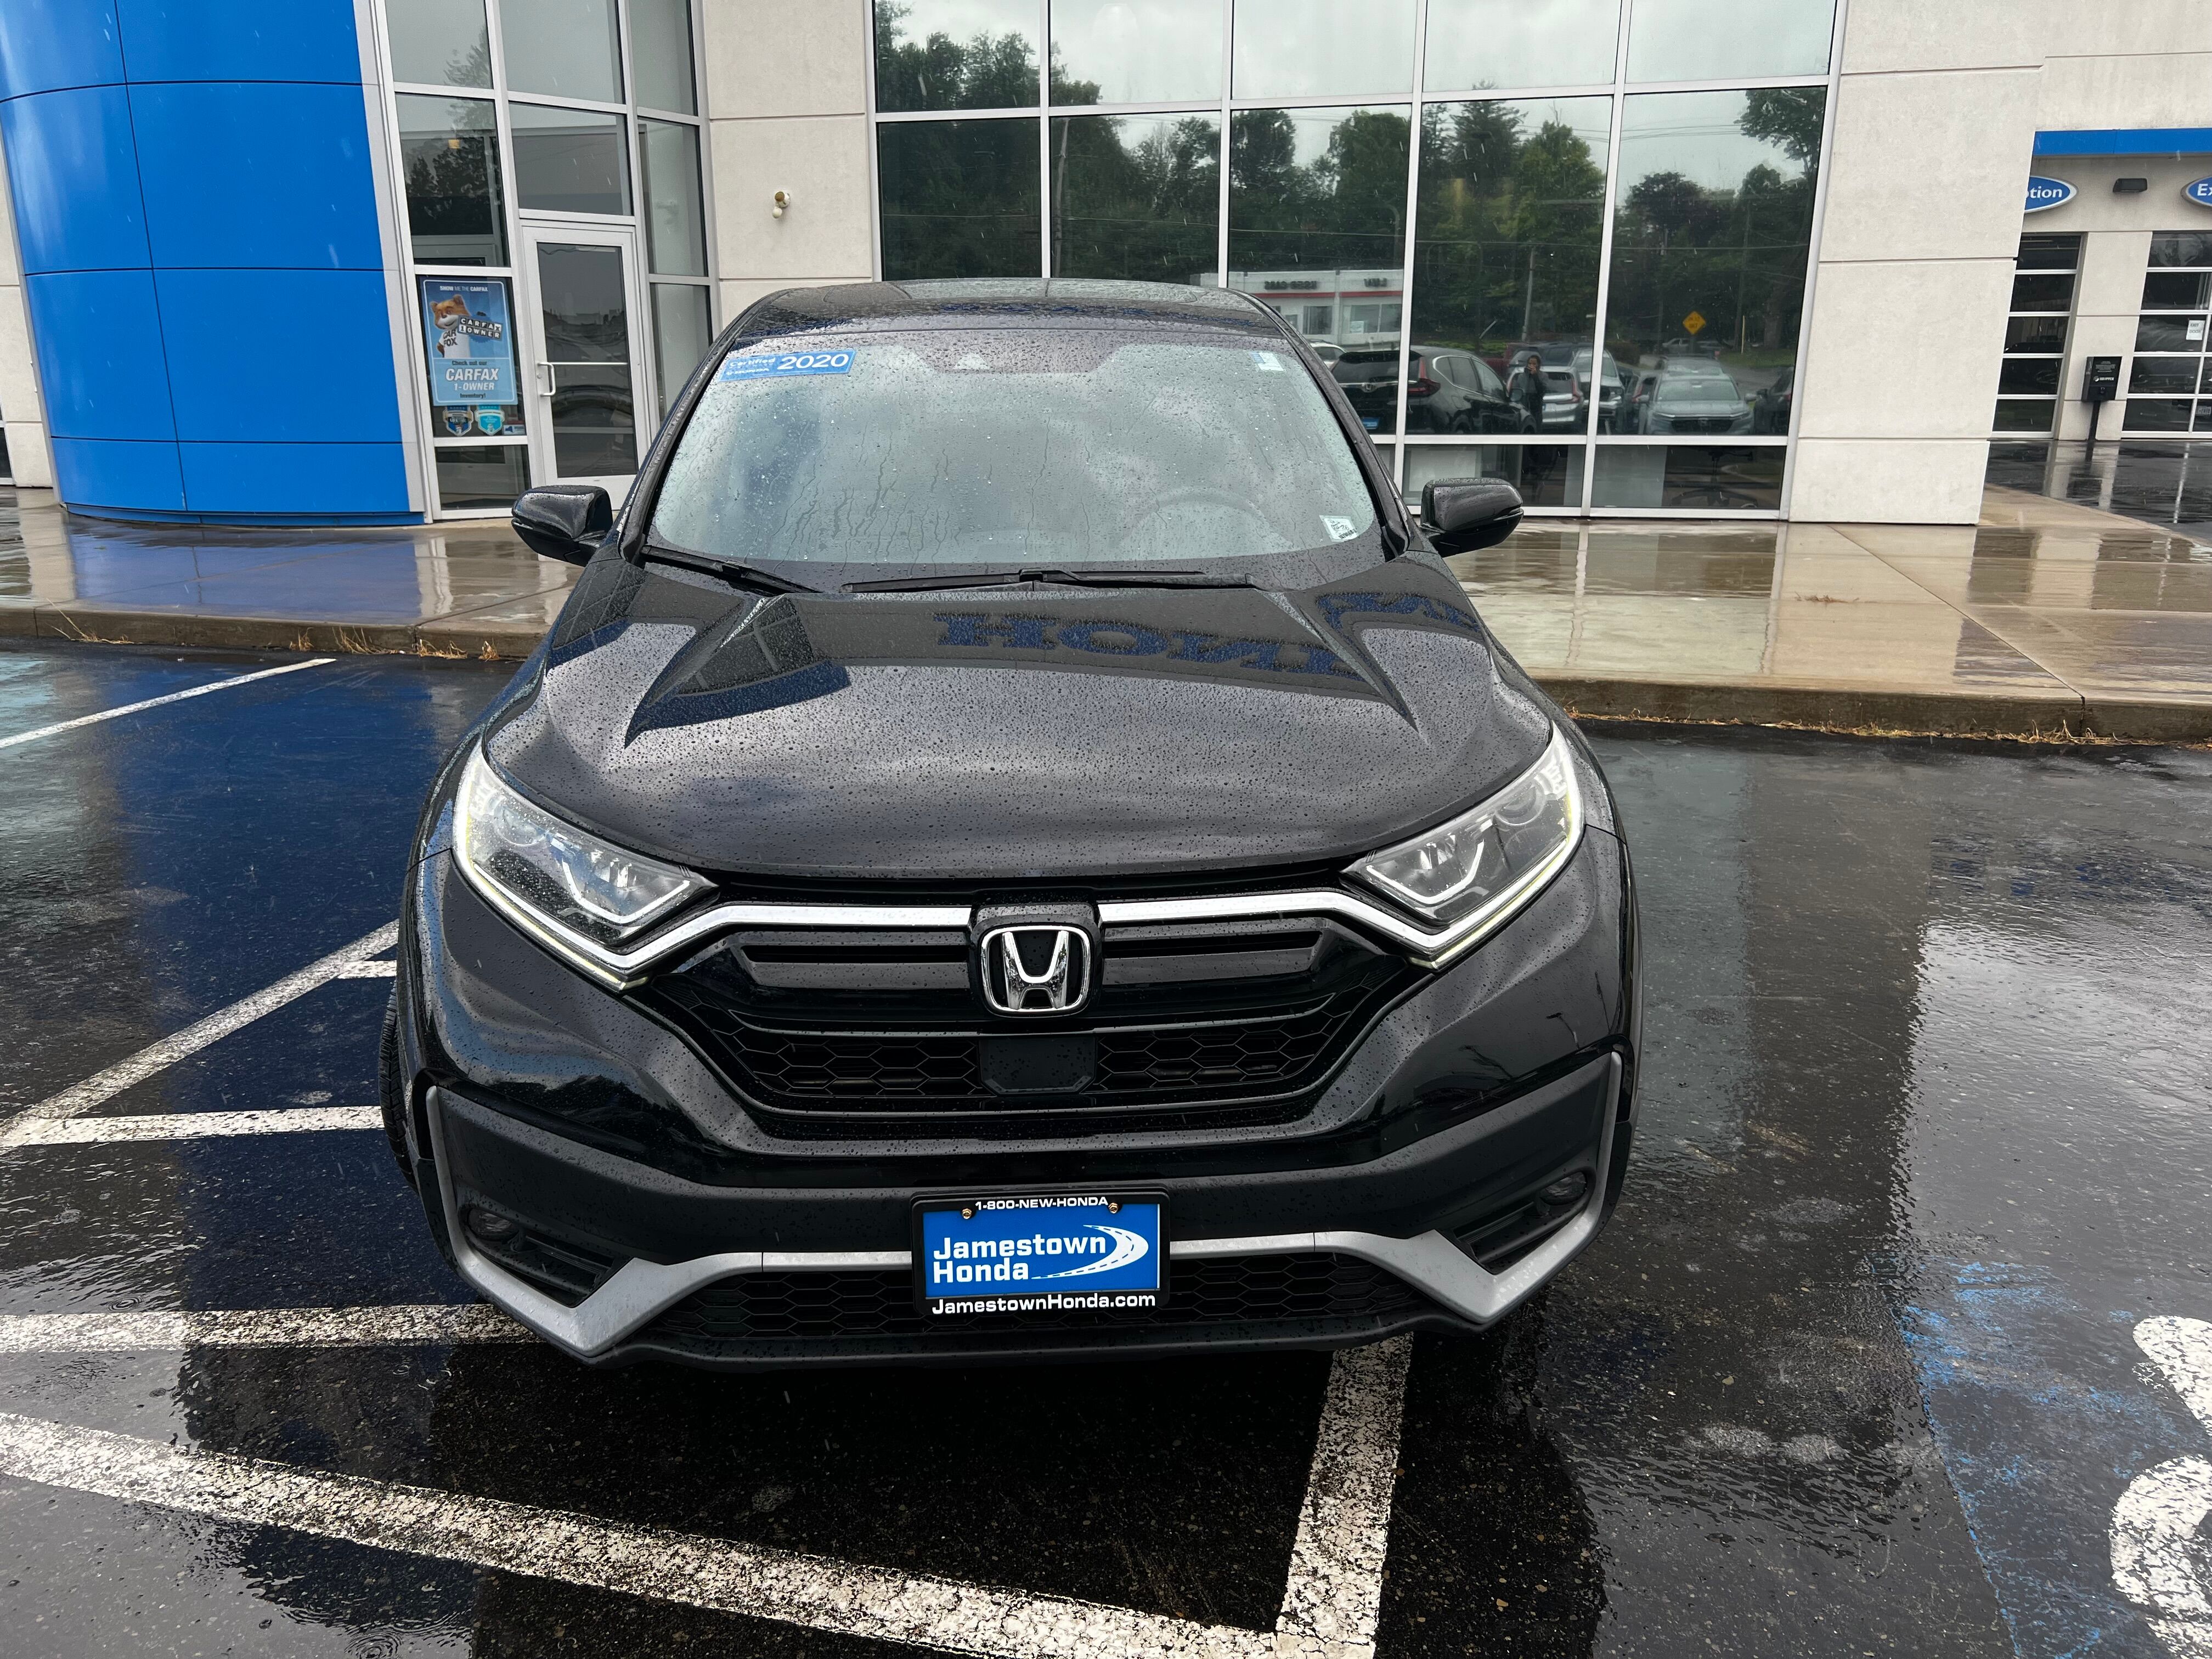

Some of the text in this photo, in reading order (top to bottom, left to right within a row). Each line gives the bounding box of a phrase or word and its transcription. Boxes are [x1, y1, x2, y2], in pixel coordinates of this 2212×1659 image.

[2028, 185, 2062, 199] tion
[461, 318, 501, 331] CARFAX
[443, 330, 457, 339] CAR
[444, 337, 458, 347] FOX
[730, 357, 776, 366] Certified
[777, 354, 849, 370] 2020
[445, 368, 499, 381] CARFAX
[454, 382, 495, 391] 1-OWNER
[975, 1197, 1108, 1211] 1-800-NEW-HONDA
[933, 1234, 1106, 1260] Jamestown
[933, 1257, 1029, 1283] Honda
[932, 1293, 1156, 1314] JamestownHonda.com
